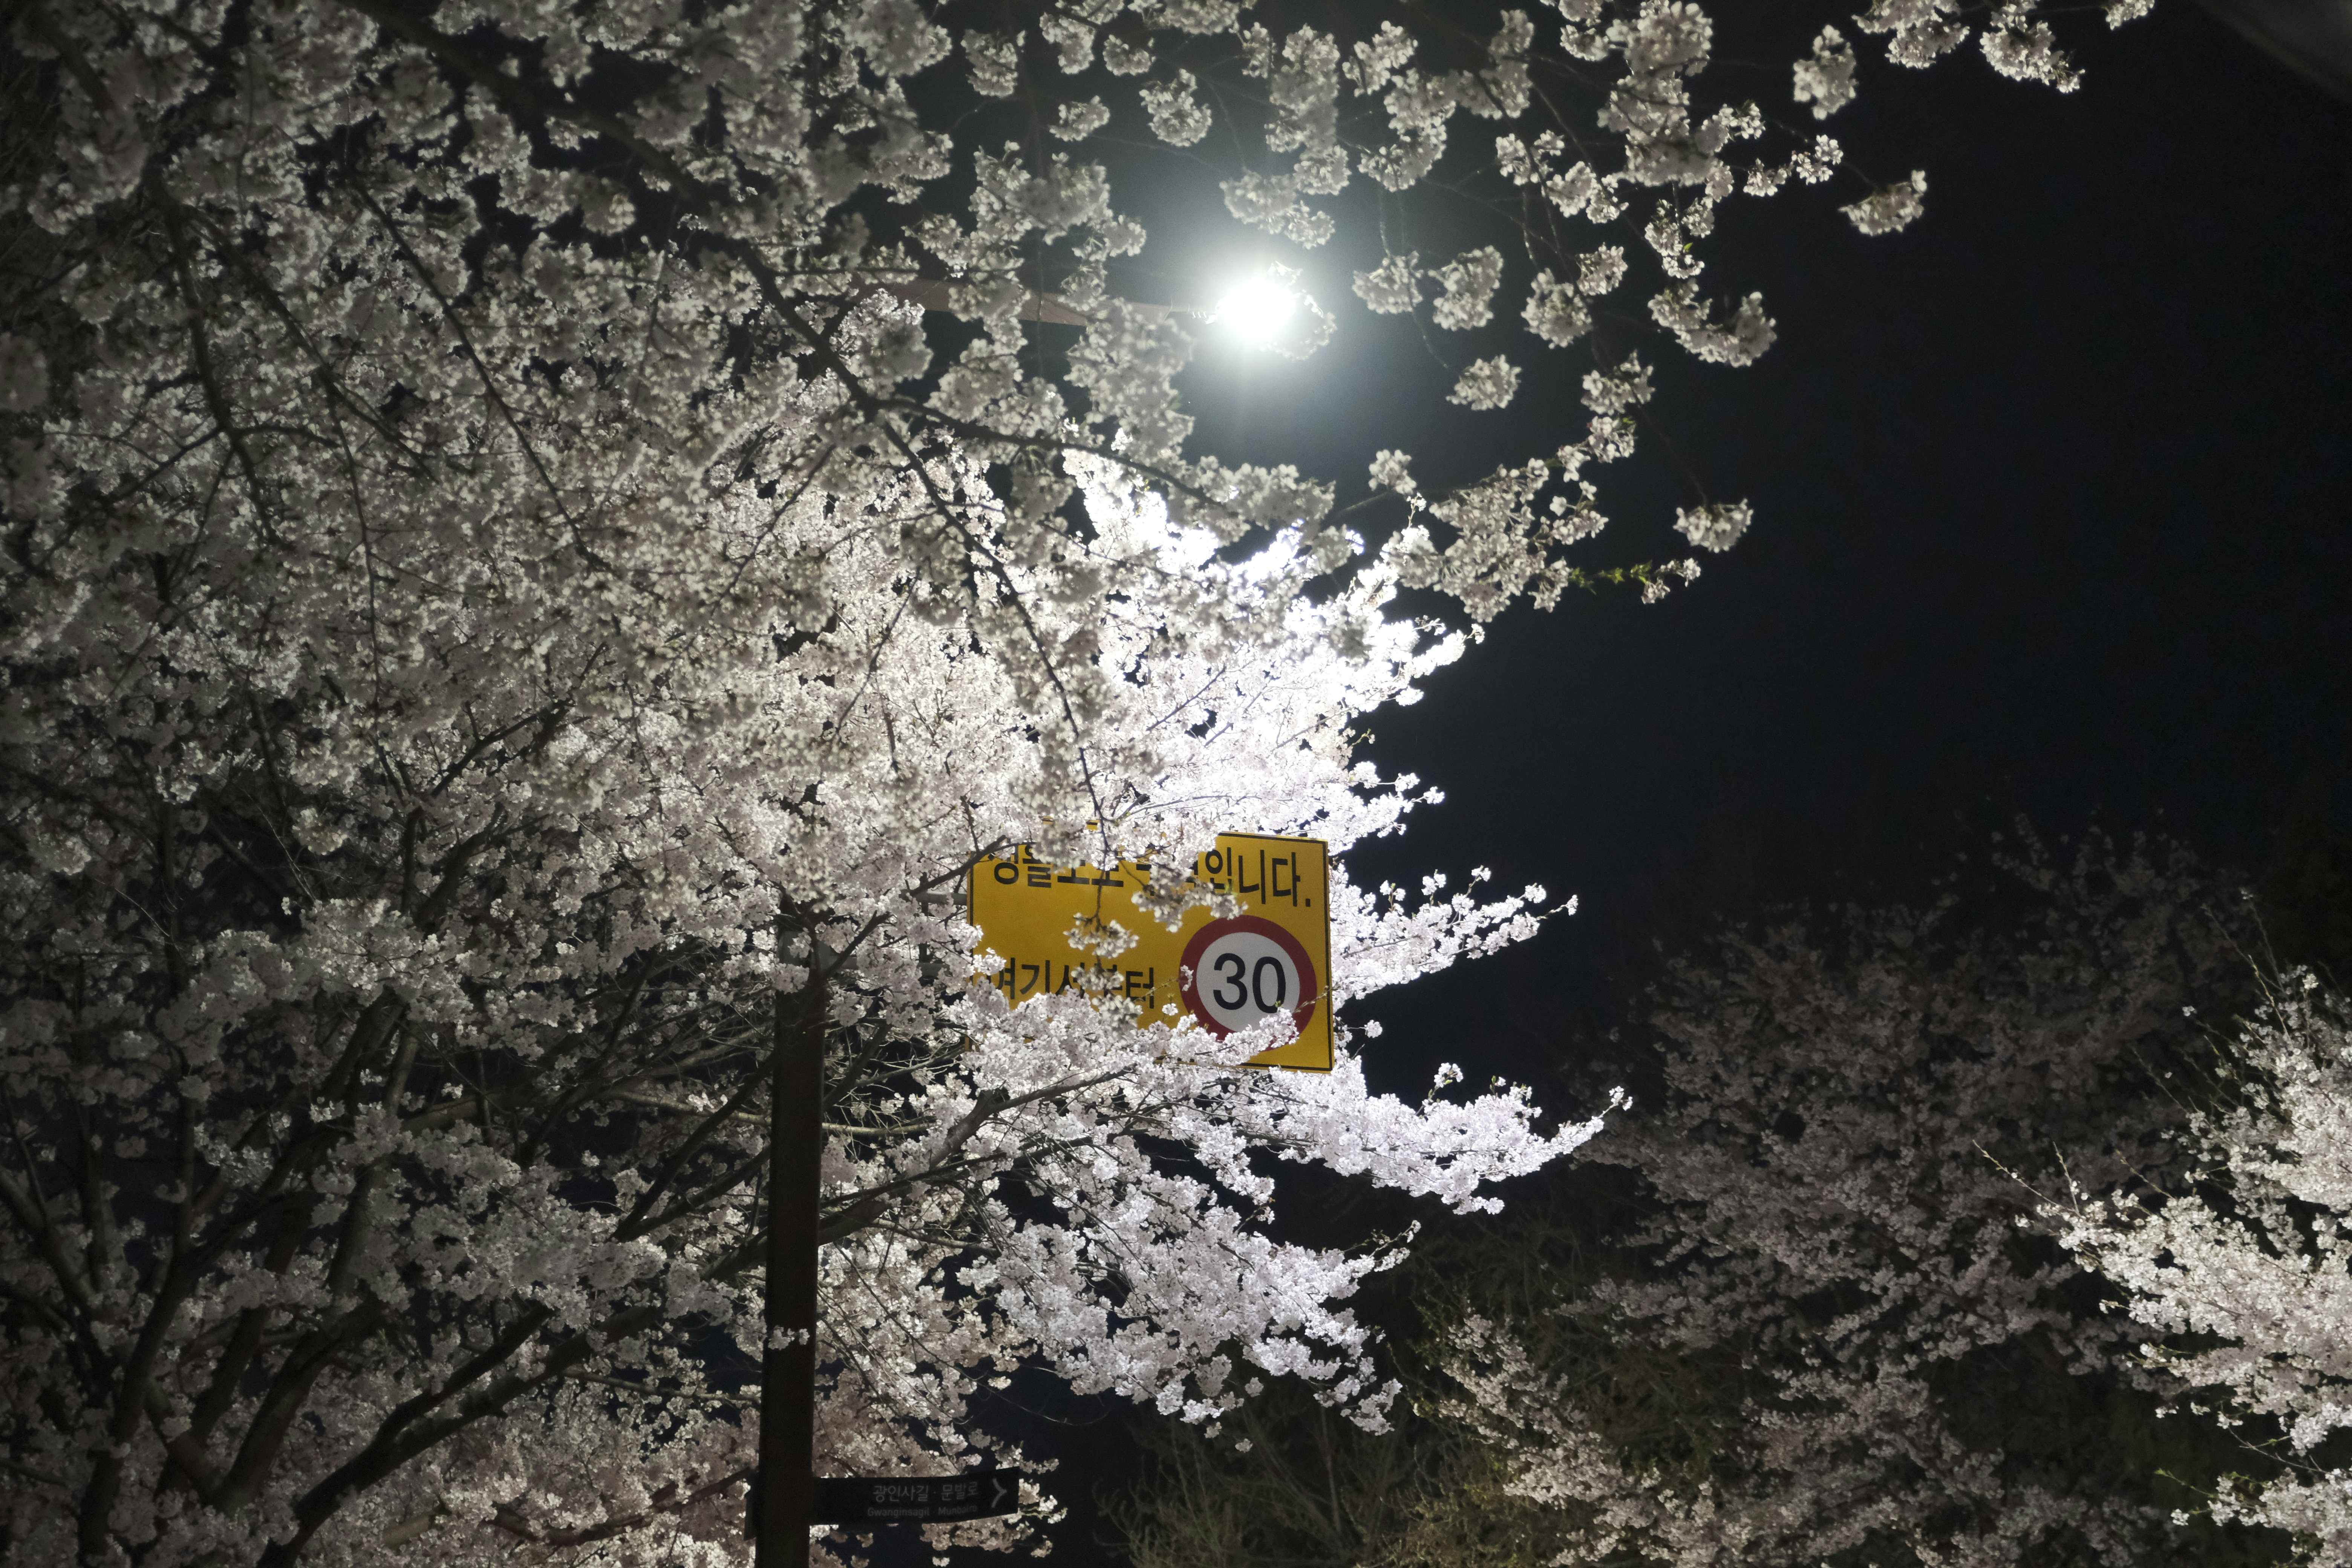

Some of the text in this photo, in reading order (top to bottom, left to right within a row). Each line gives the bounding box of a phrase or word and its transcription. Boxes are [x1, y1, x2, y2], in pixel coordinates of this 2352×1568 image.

[1213, 952, 1286, 1014] 30
[873, 1481, 978, 1503] 광인사길 문발로
[868, 1507, 929, 1518] Gwanginsagil
